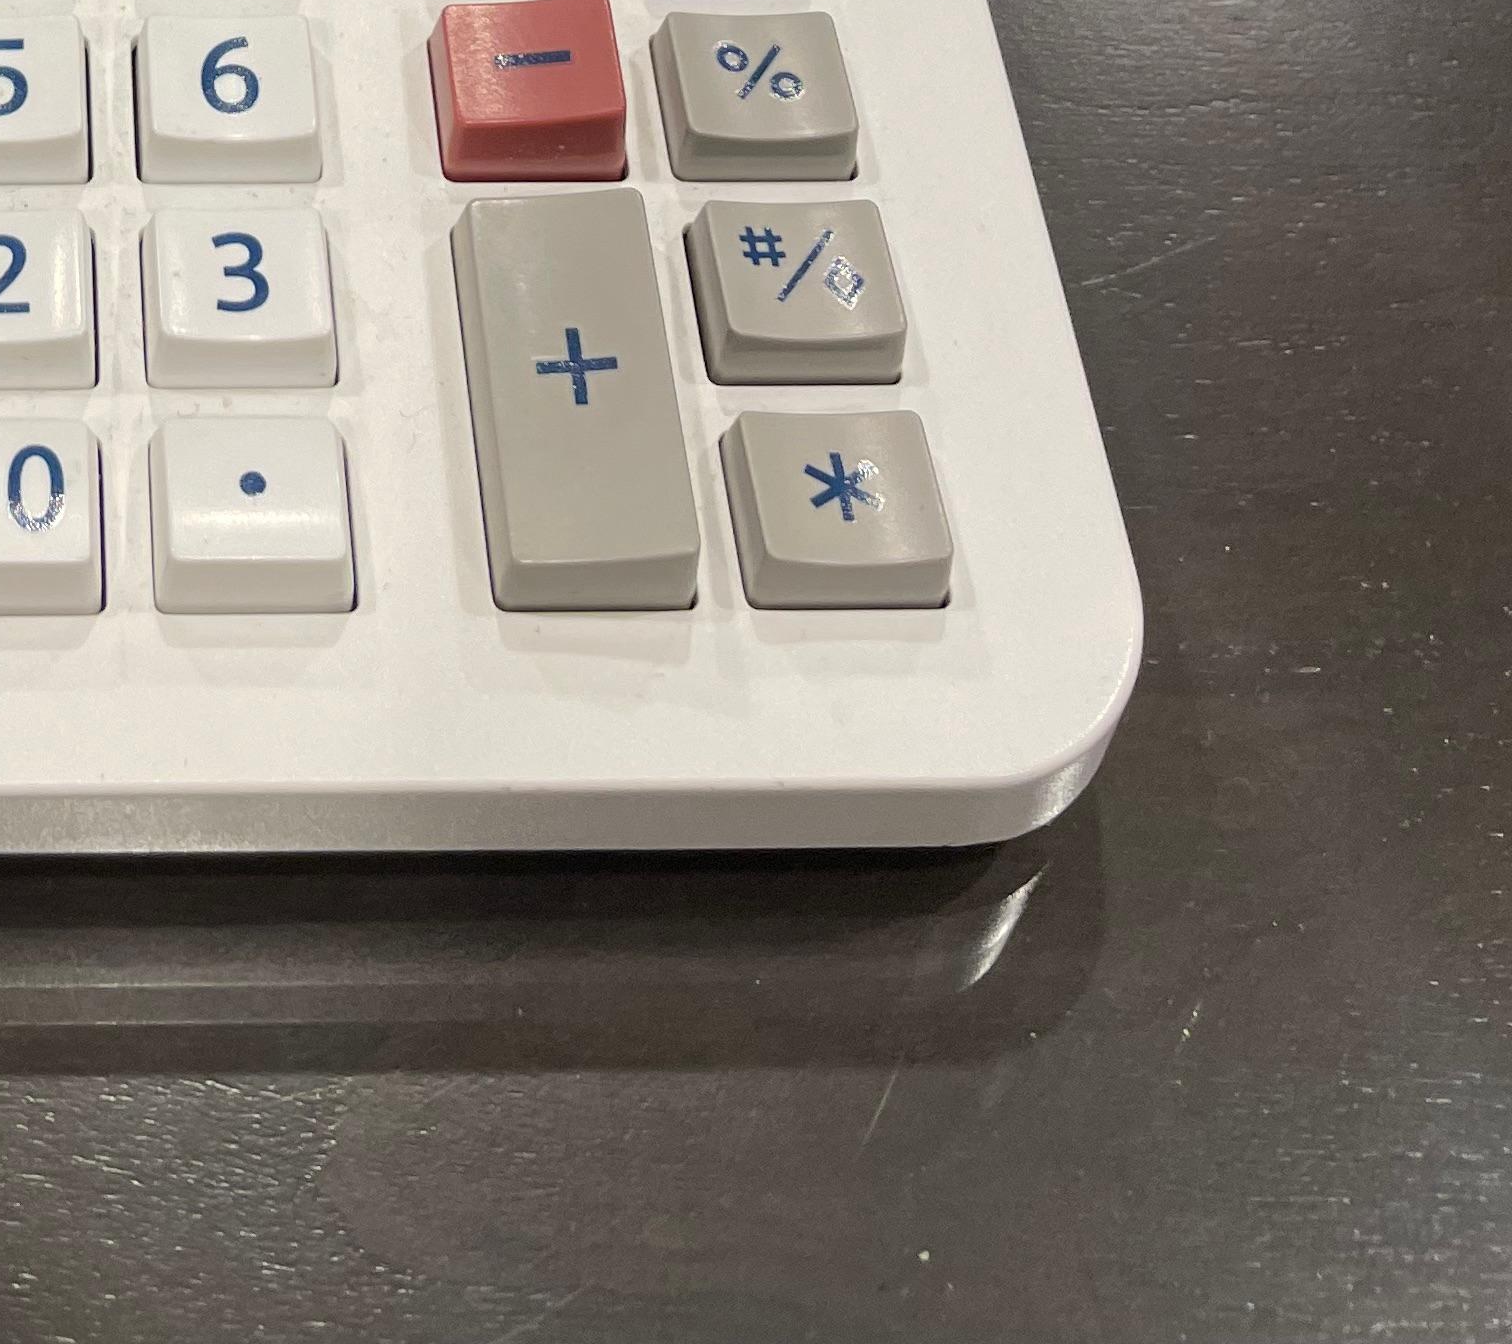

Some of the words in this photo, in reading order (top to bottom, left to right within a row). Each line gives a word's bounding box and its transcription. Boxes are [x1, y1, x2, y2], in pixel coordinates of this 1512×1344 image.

[200, 36, 261, 114] 6
[715, 41, 804, 100] %
[211, 231, 270, 313] 3
